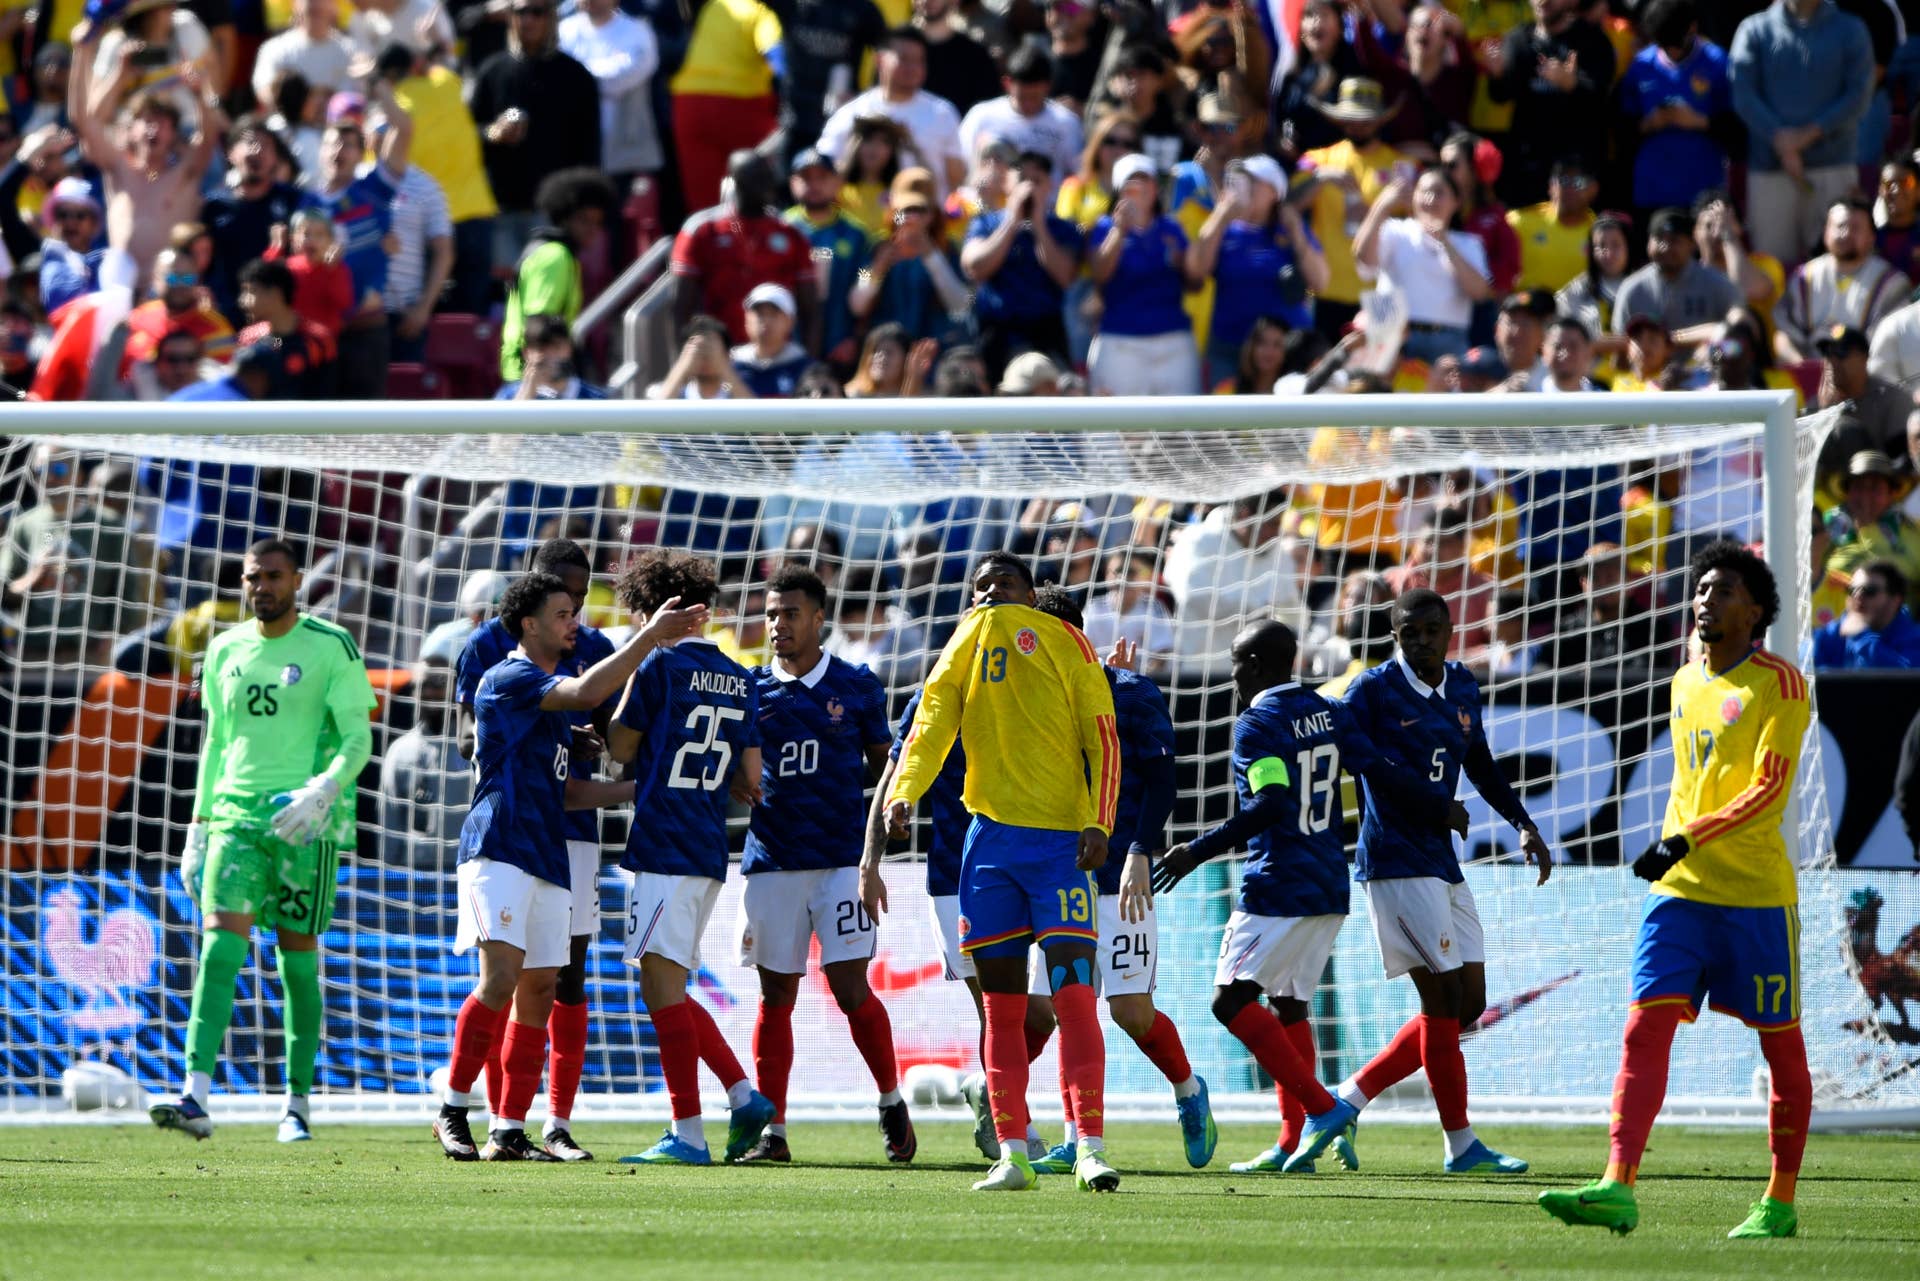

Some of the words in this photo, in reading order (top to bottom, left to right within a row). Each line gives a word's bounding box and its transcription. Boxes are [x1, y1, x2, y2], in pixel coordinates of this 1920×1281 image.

[981, 646, 1008, 684] 13
[247, 684, 278, 716] 25
[689, 671, 748, 698] AKLIOUCHE
[1292, 710, 1334, 739] KNTE
[553, 743, 569, 781] 18
[667, 704, 745, 791] 25
[779, 739, 819, 776] 20
[1428, 747, 1447, 782] 5
[1690, 729, 1715, 771] 17
[1297, 743, 1339, 835] 13
[279, 885, 312, 920] 25
[628, 900, 639, 935] 5
[836, 900, 872, 936] 20
[1057, 887, 1089, 922] 13
[1112, 933, 1150, 970] 24
[1220, 927, 1233, 959] 3
[1753, 974, 1786, 1014] 17
